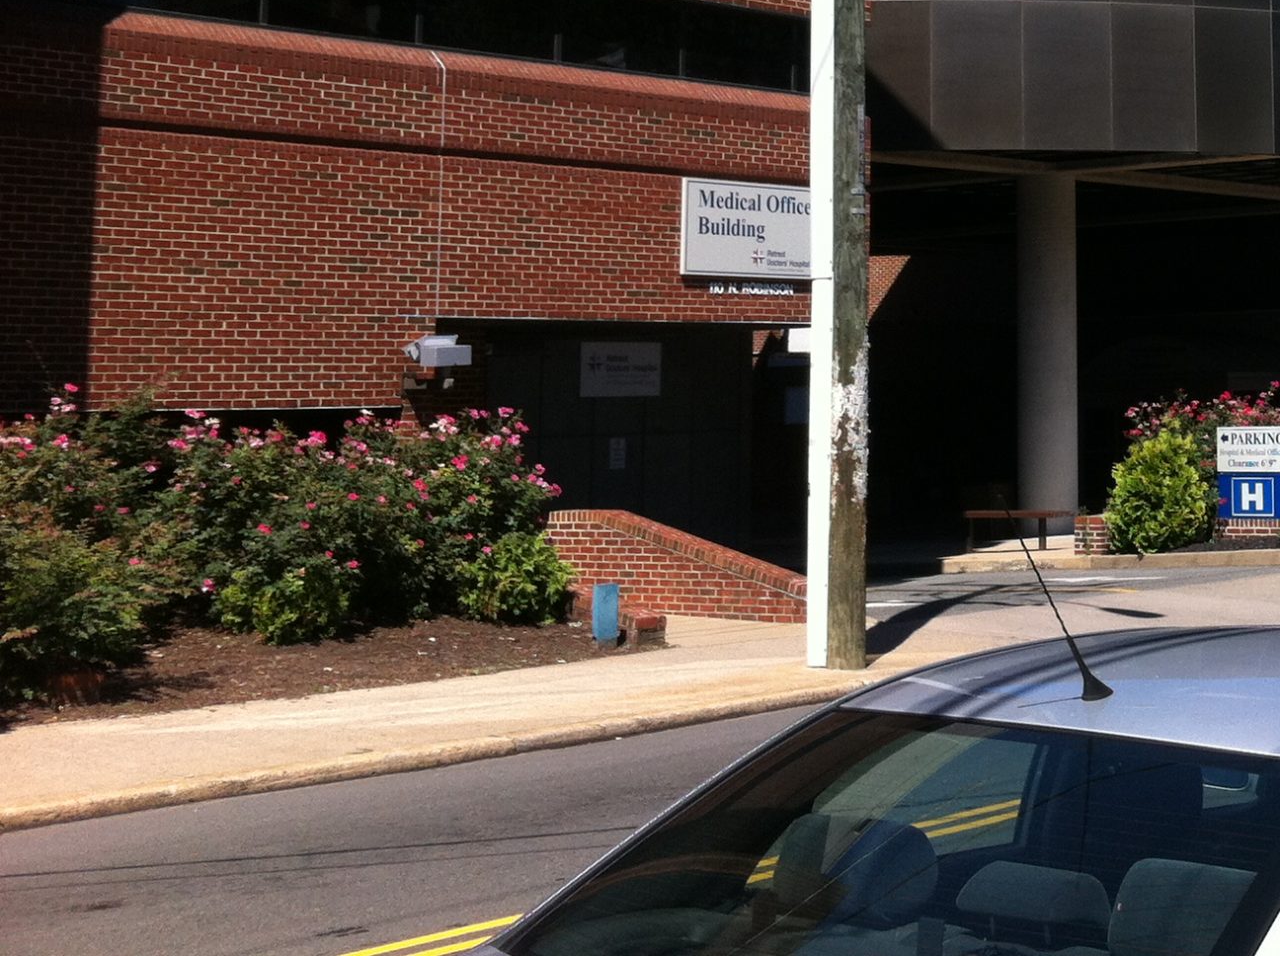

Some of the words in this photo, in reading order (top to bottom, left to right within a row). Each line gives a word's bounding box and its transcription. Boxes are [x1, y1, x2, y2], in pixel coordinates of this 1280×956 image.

[699, 189, 761, 212] Medical
[766, 194, 811, 215] Office
[698, 216, 766, 243] Building
[789, 260, 811, 269] Hospital
[742, 283, 795, 296] ROBINSON
[1228, 459, 1259, 467] Clearance
[1241, 482, 1264, 511] H
